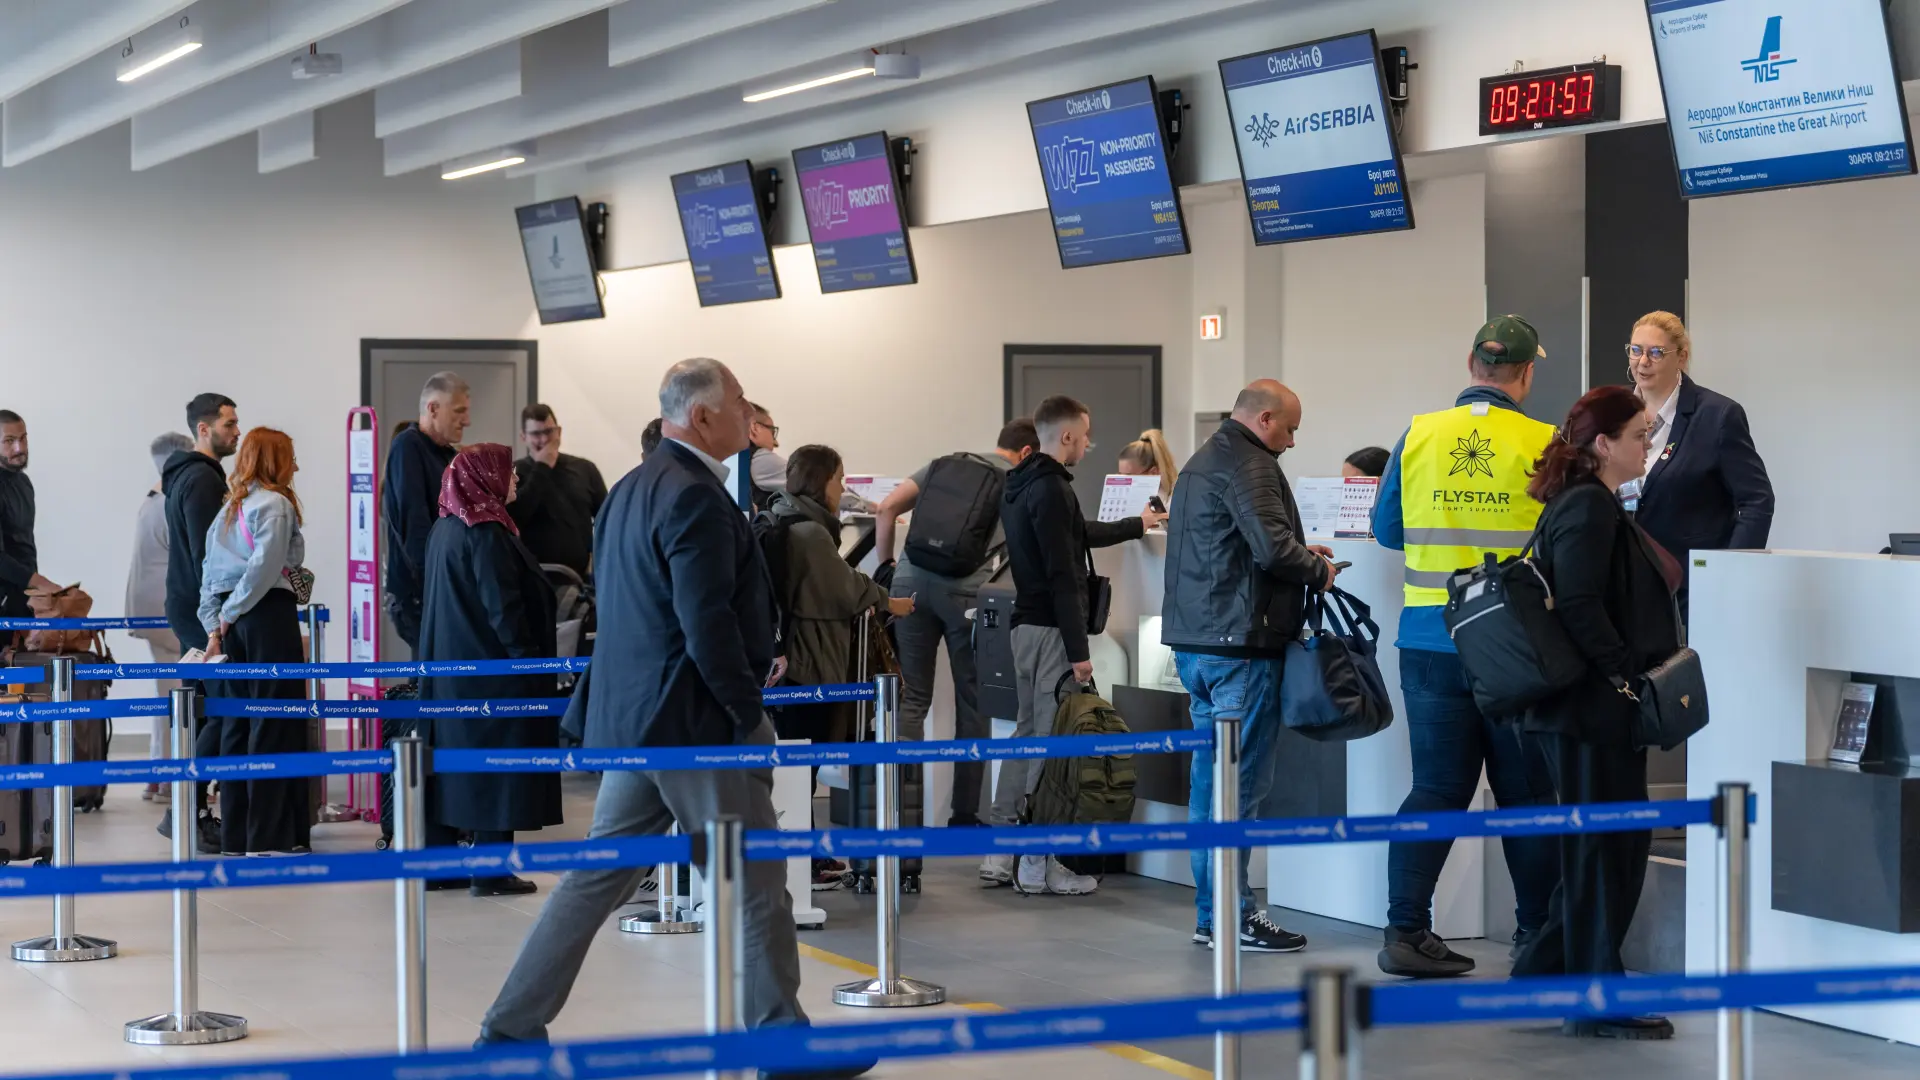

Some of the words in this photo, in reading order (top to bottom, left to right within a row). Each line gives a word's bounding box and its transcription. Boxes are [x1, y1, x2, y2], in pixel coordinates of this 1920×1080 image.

[1267, 50, 1311, 74] Check-in
[1066, 94, 1102, 116] Check-in
[1490, 76, 1593, 124] 09:21:57
[1688, 105, 1736, 124] Аеродром
[1738, 94, 1801, 114] Константин
[1803, 88, 1845, 104] Велики
[1848, 84, 1874, 98] Ниш
[1698, 130, 1714, 144] Niš
[1716, 122, 1776, 142] Constantine
[1778, 118, 1796, 134] the
[1798, 114, 1827, 131] Great
[1830, 110, 1868, 129] Airport
[1100, 132, 1156, 156] NON-PRIORITY
[1848, 152, 1873, 165] 30APR
[1874, 148, 1904, 162] 09:21:57
[1104, 156, 1156, 178] PASSENGERS
[1718, 166, 1732, 174] Србије
[1368, 169, 1382, 182] Број
[1382, 169, 1396, 178] лета
[1248, 184, 1280, 197] Дестинација
[1374, 181, 1398, 196] JU1101
[848, 184, 890, 208] PRIORITY
[1252, 200, 1280, 212] Београд
[1433, 490, 1510, 504] FLYSTAR
[129, 668, 150, 676] Airports
[364, 666, 395, 674] Аеродроми
[396, 666, 416, 674] Србије
[33, 708, 59, 716] Airports
[129, 704, 167, 712] Аеродроми
[245, 704, 282, 712] Аеродроми
[283, 705, 306, 713] Србије
[418, 705, 455, 713] Аеродроми
[456, 705, 478, 713] Србије
[496, 704, 520, 712] Airports
[622, 756, 647, 764] Serbia
[826, 751, 849, 759] Serbia
[248, 761, 275, 770] Serbia
[16, 772, 44, 780] Serbia
